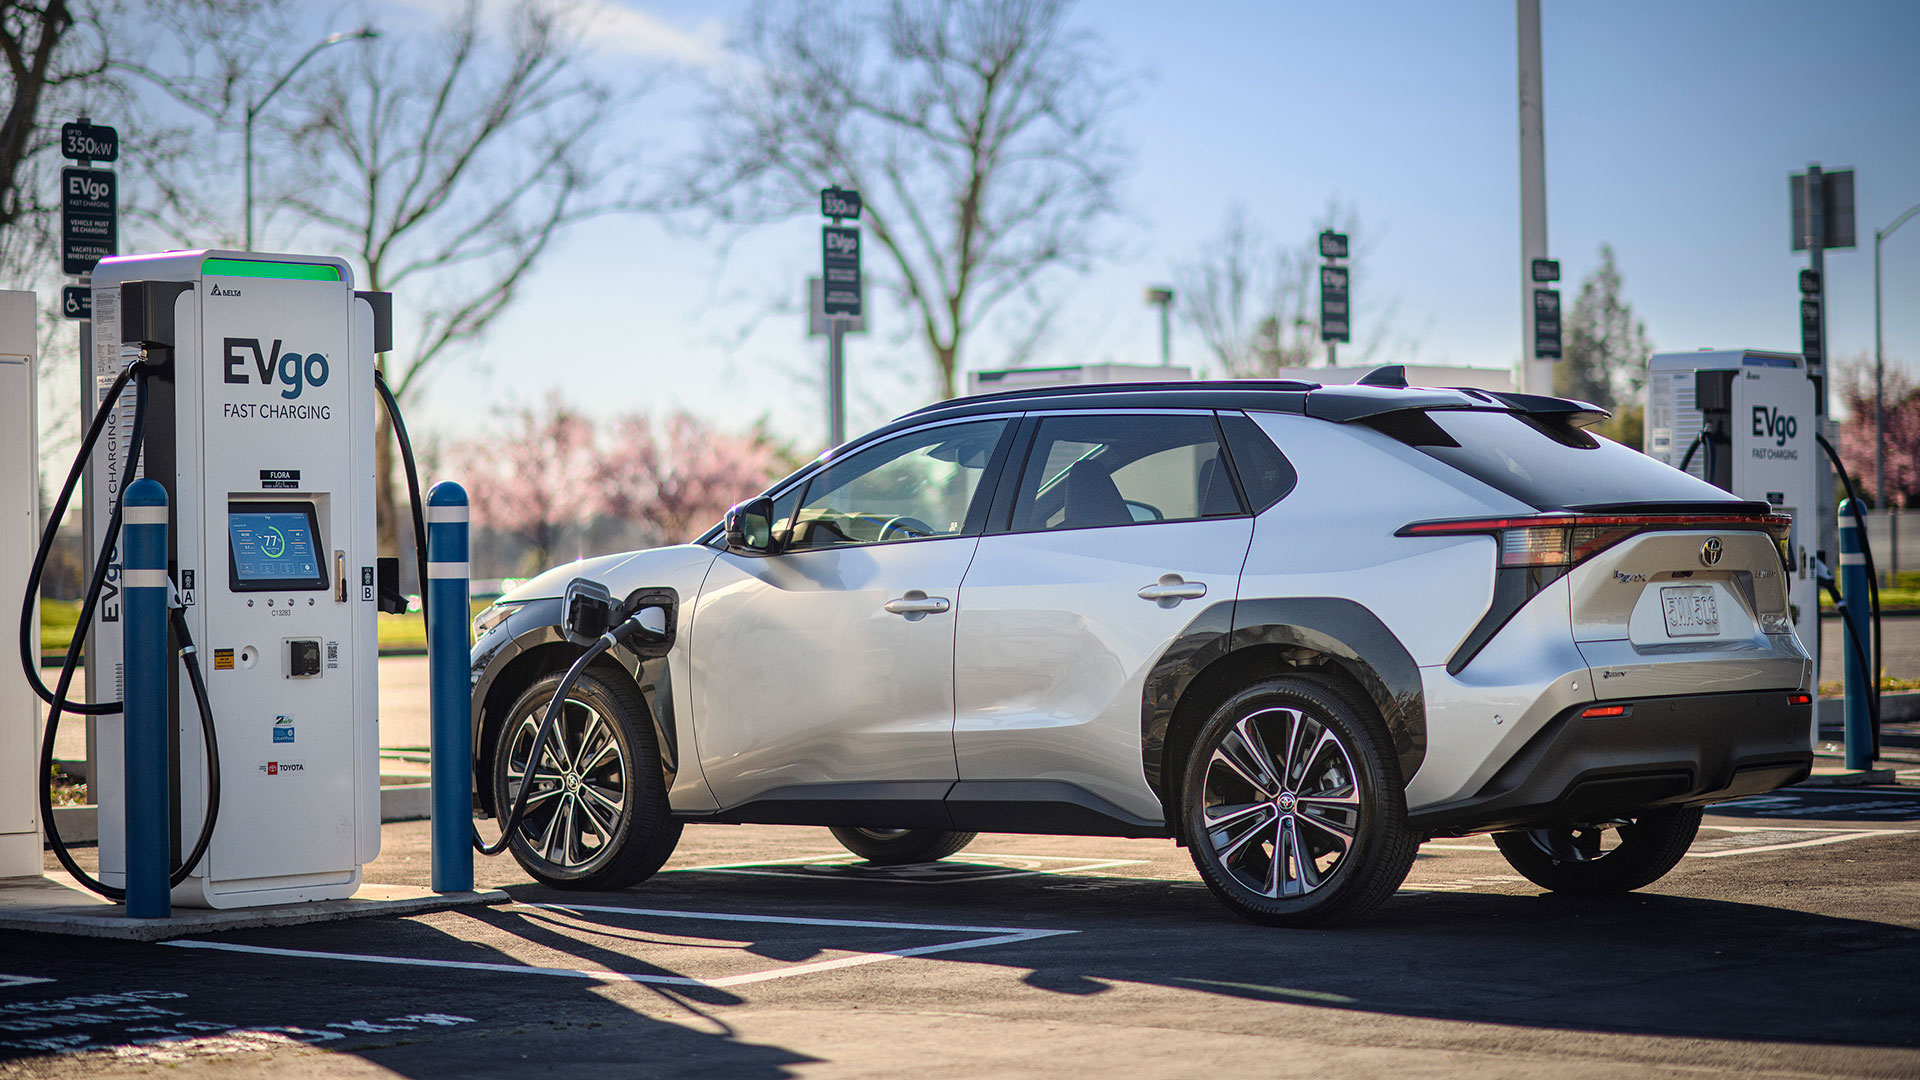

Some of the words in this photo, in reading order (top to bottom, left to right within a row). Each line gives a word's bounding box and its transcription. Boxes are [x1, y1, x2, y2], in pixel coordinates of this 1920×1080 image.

[67, 136, 112, 156] 350kW
[70, 177, 109, 200] EVgo
[83, 200, 110, 208] CHARGING
[70, 219, 93, 227] VEHICLE
[80, 227, 108, 235] CHARGING
[826, 233, 857, 253] EVgo
[224, 337, 329, 400] EVgo
[224, 403, 257, 418] FAST
[259, 404, 331, 420] CHARGING
[1752, 406, 1797, 447] EVgo
[108, 414, 118, 493] CHARGING
[1752, 448, 1766, 459] FAST
[1767, 448, 1798, 460] CHARGING
[270, 471, 290, 479] FLORA
[185, 591, 193, 603] A
[365, 587, 371, 598] B
